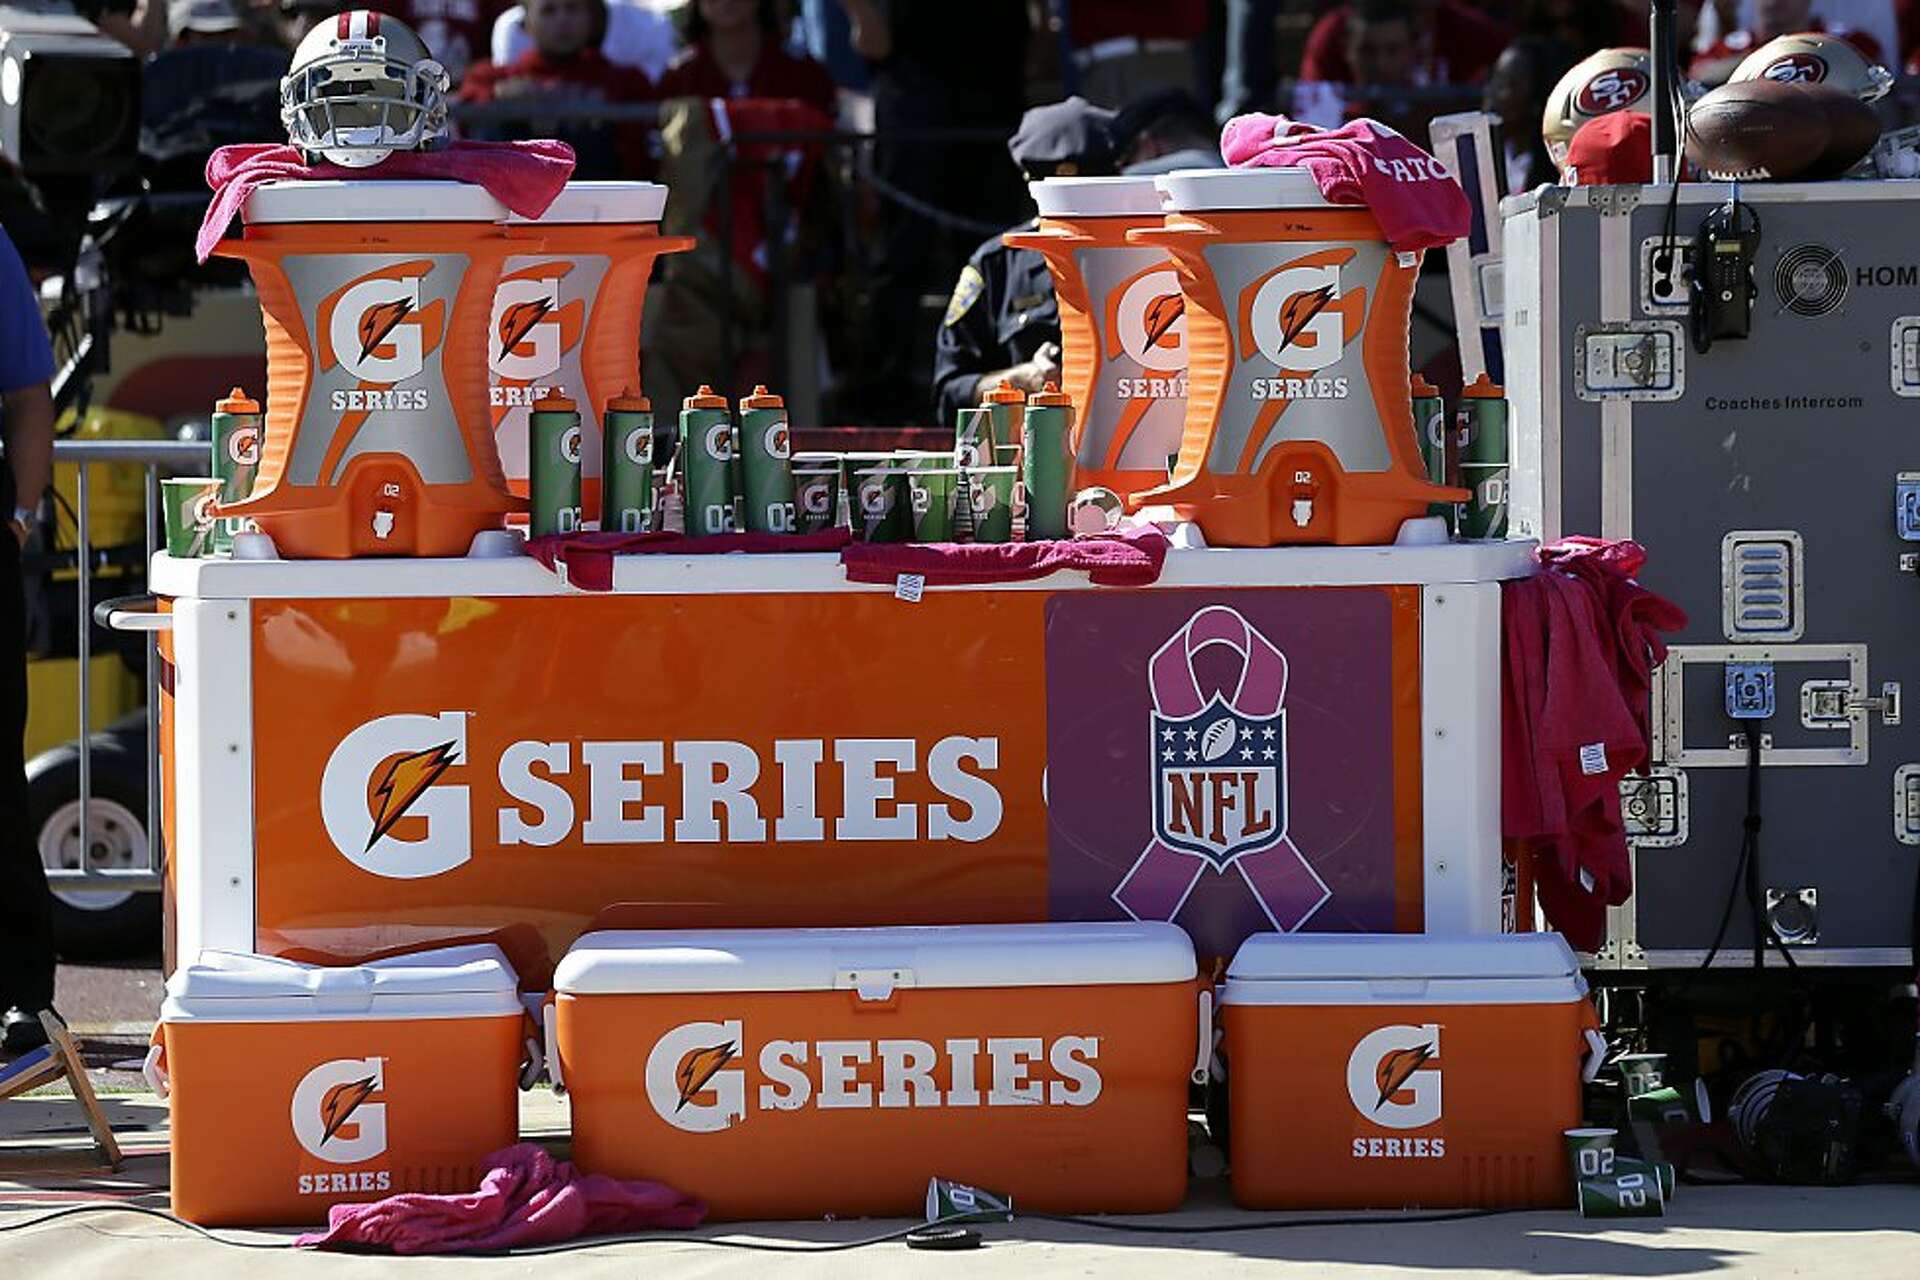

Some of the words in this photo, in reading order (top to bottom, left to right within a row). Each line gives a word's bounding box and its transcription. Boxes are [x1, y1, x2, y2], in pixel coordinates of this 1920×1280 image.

[1856, 266, 1918, 287] HOM
[330, 276, 424, 383] G
[488, 277, 561, 382] G
[1117, 270, 1188, 371] G
[1251, 264, 1344, 371] G
[331, 388, 430, 412] SERIES
[1251, 377, 1350, 400] SERIES
[1705, 396, 1781, 411] Coaches
[1785, 395, 1864, 409] Intercom
[228, 427, 259, 466] G
[625, 426, 654, 465] G
[706, 423, 733, 461] G
[765, 421, 791, 460] G
[384, 483, 400, 497] 02
[1295, 471, 1311, 484] 02
[804, 484, 830, 513] G
[861, 484, 885, 514] G
[705, 504, 735, 533] 02
[767, 503, 796, 532] 02
[320, 711, 471, 879] G
[498, 735, 1003, 847] SERIES
[1167, 771, 1272, 847] NFL
[645, 1019, 746, 1133] G
[758, 1035, 1103, 1111] SERIES
[1346, 1023, 1444, 1129] G
[290, 1056, 388, 1164] G
[1352, 1137, 1446, 1158] SERIES
[1579, 1148, 1616, 1176] 02
[298, 1170, 392, 1194] SERIES
[1616, 1172, 1647, 1208] 02
